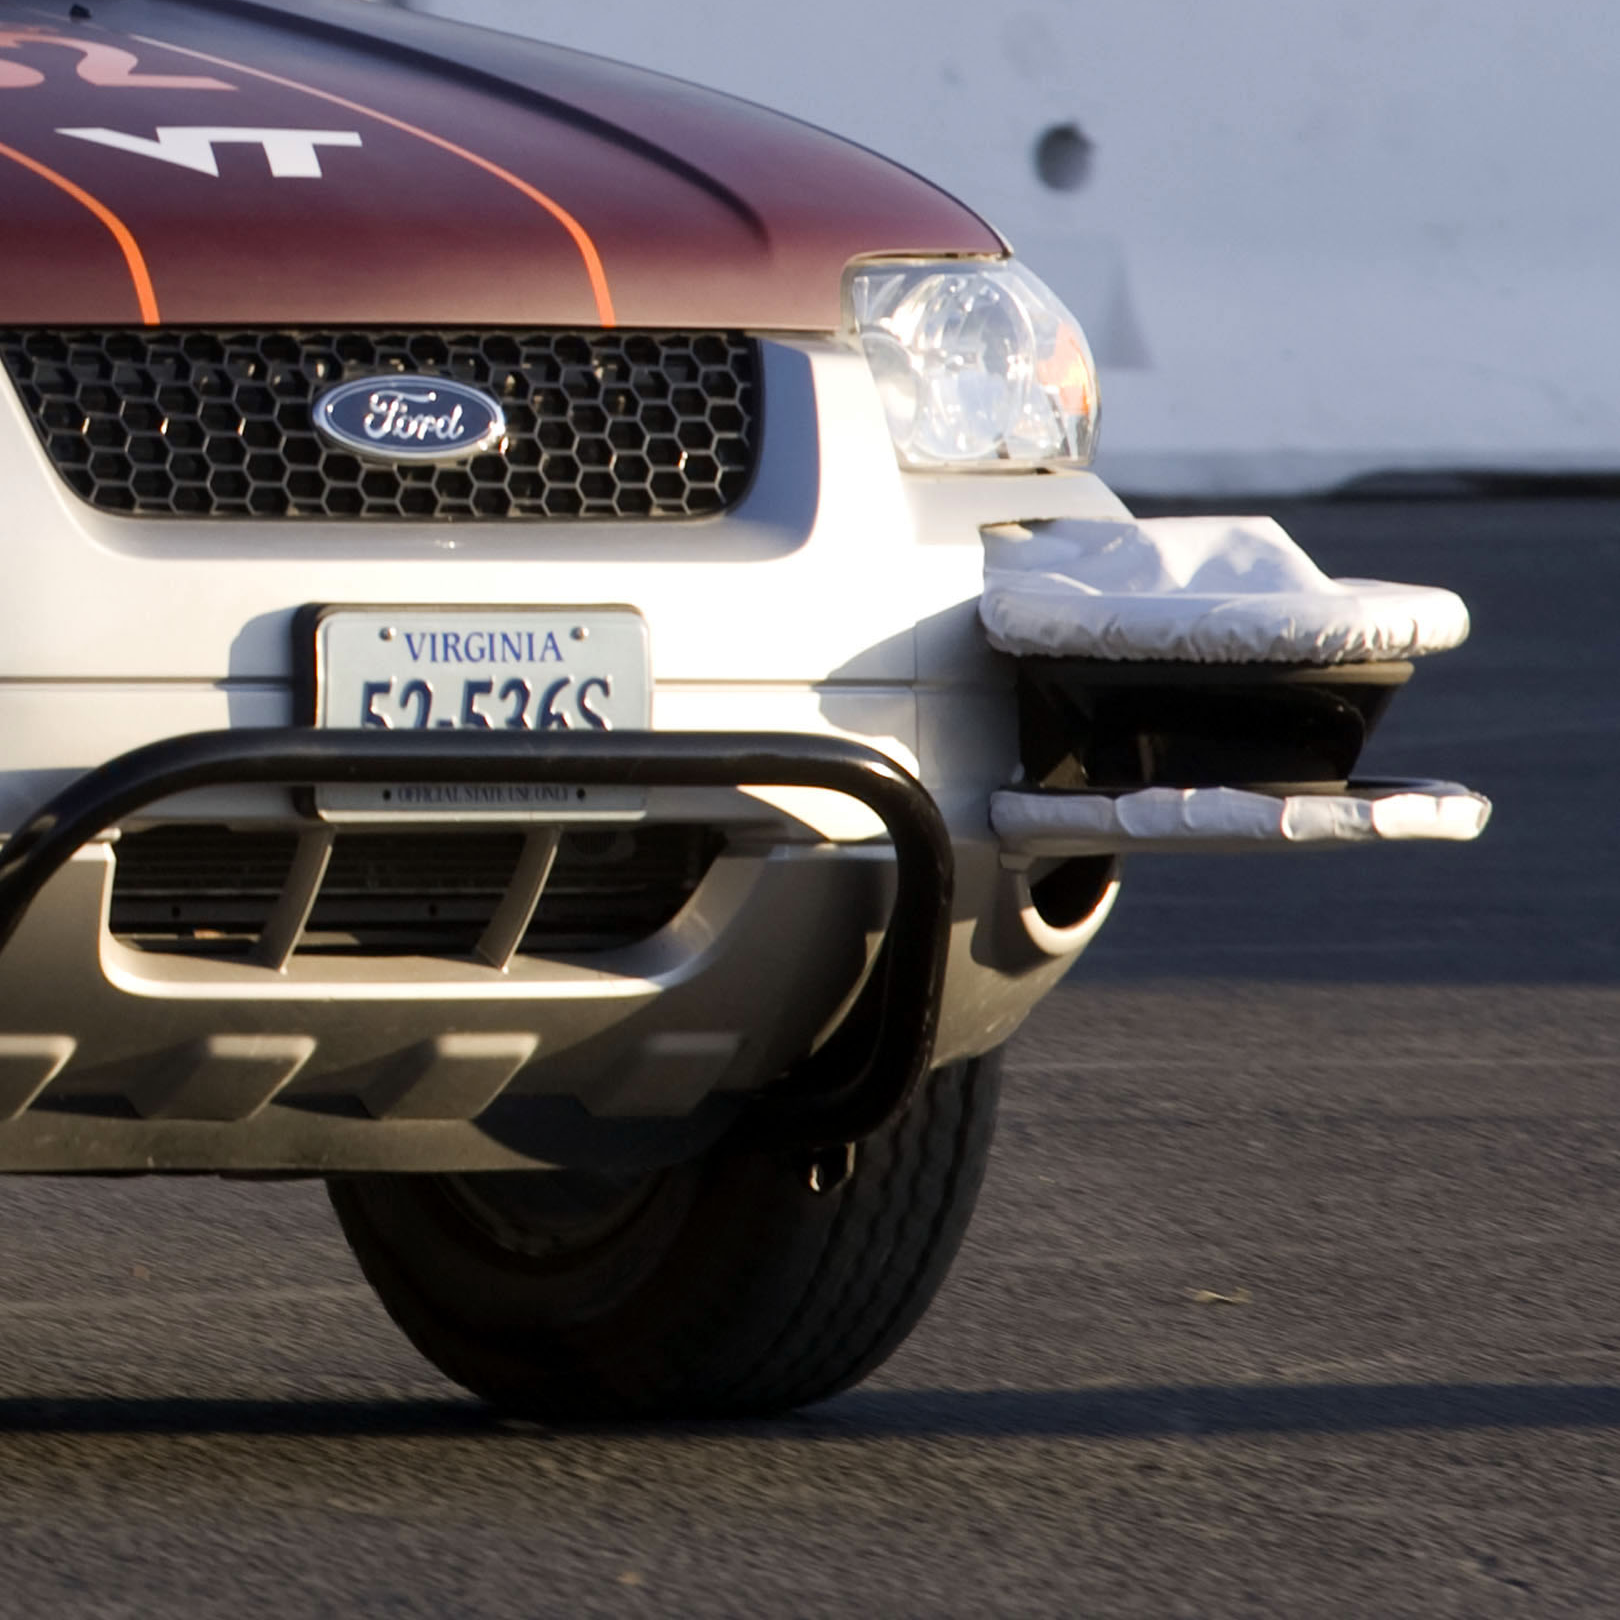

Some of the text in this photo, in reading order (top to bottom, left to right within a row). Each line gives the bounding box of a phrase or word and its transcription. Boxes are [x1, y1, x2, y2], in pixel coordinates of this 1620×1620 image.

[53, 125, 363, 179] VT
[364, 389, 465, 442] Ford
[403, 630, 565, 664] VIRGINIA
[464, 784, 505, 804] STATE
